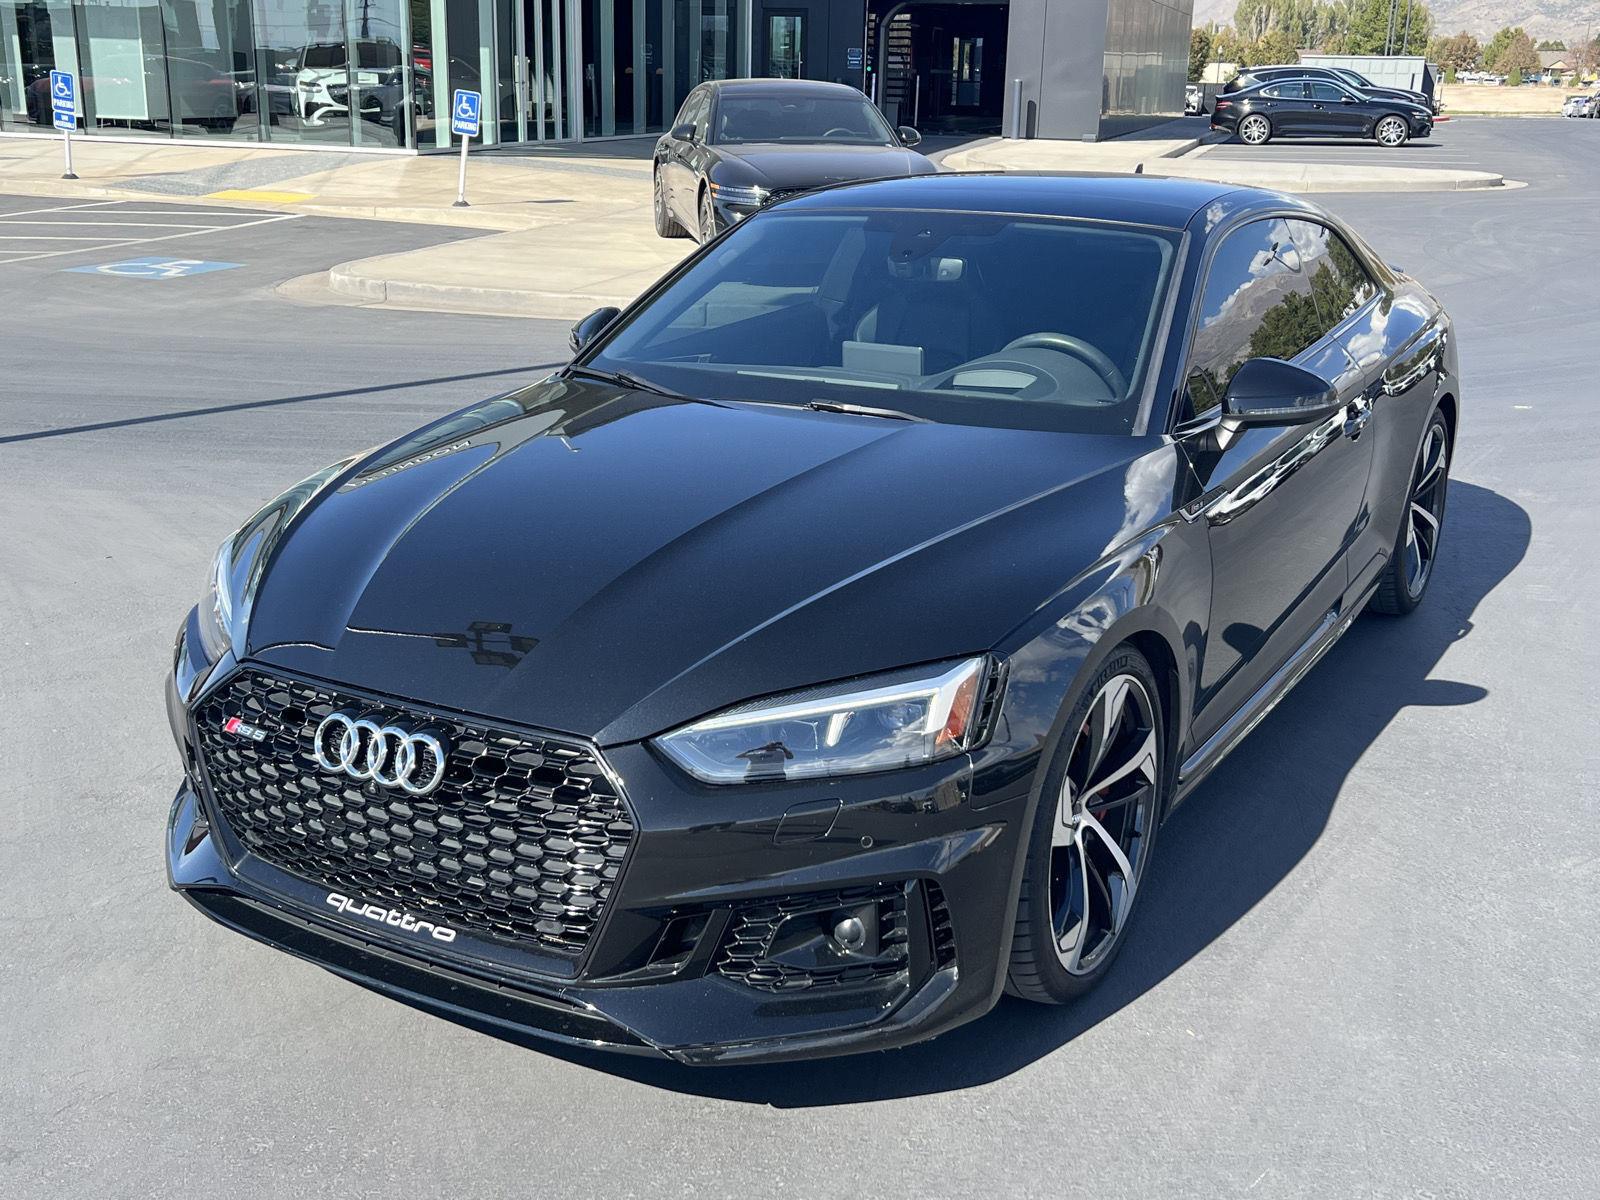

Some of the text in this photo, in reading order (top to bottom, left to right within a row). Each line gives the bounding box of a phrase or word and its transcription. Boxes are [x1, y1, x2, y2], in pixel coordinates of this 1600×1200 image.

[53, 98, 74, 109] PARKING
[454, 119, 477, 131] PARKING
[326, 892, 457, 942] quattro
